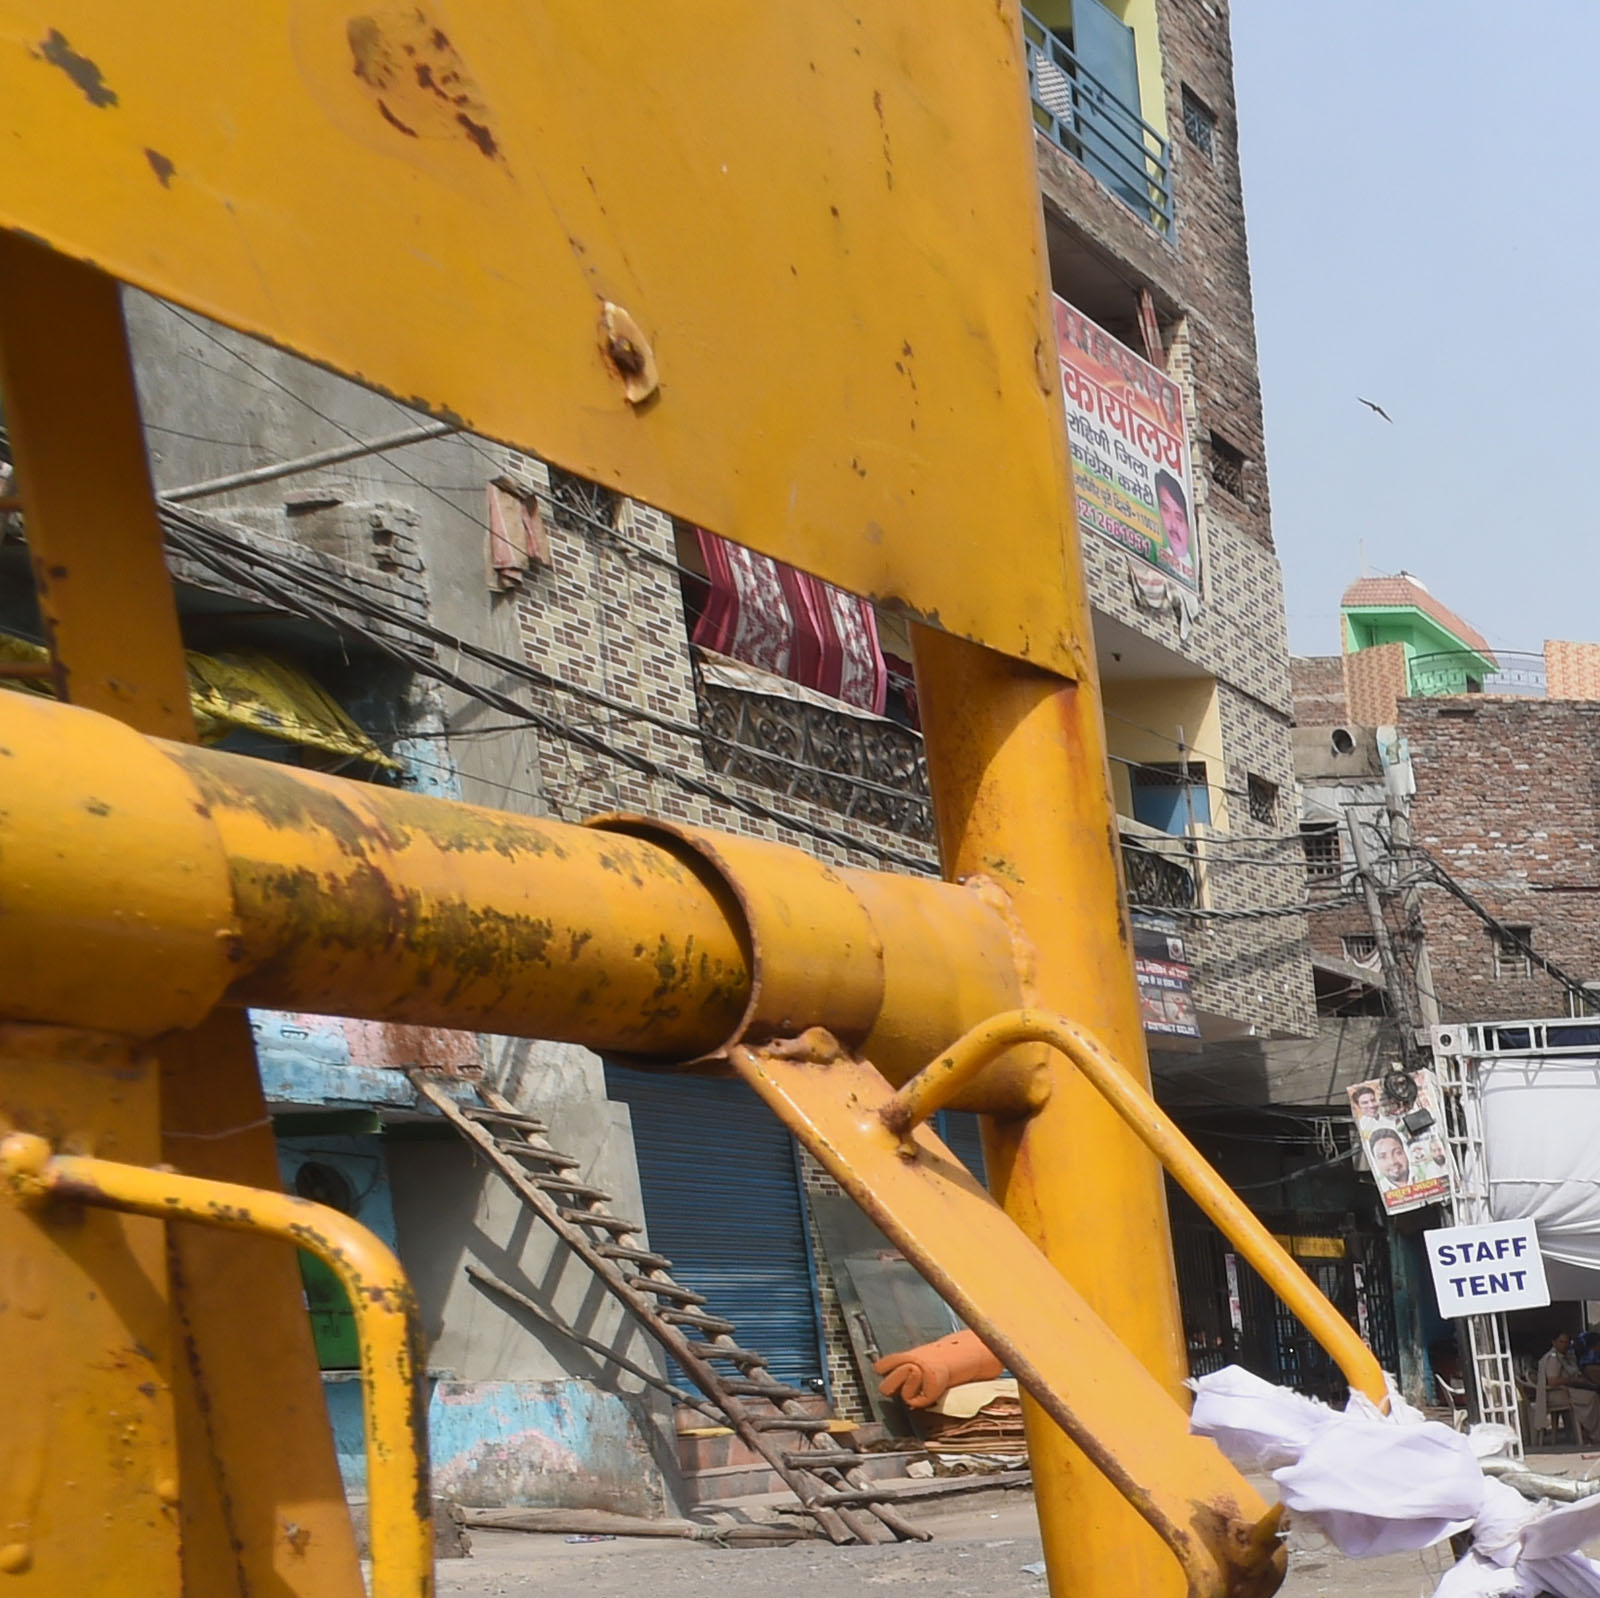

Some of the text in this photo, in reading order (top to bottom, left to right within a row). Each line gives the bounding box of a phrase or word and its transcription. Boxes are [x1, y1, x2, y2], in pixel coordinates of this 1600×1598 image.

[1060, 358, 1183, 478] कार्यालय
[1067, 410, 1149, 480] रोहिणी जिला
[1118, 472, 1155, 507] कमेटी
[1438, 1236, 1527, 1266] STAFF
[1449, 1270, 1527, 1298] TENT
